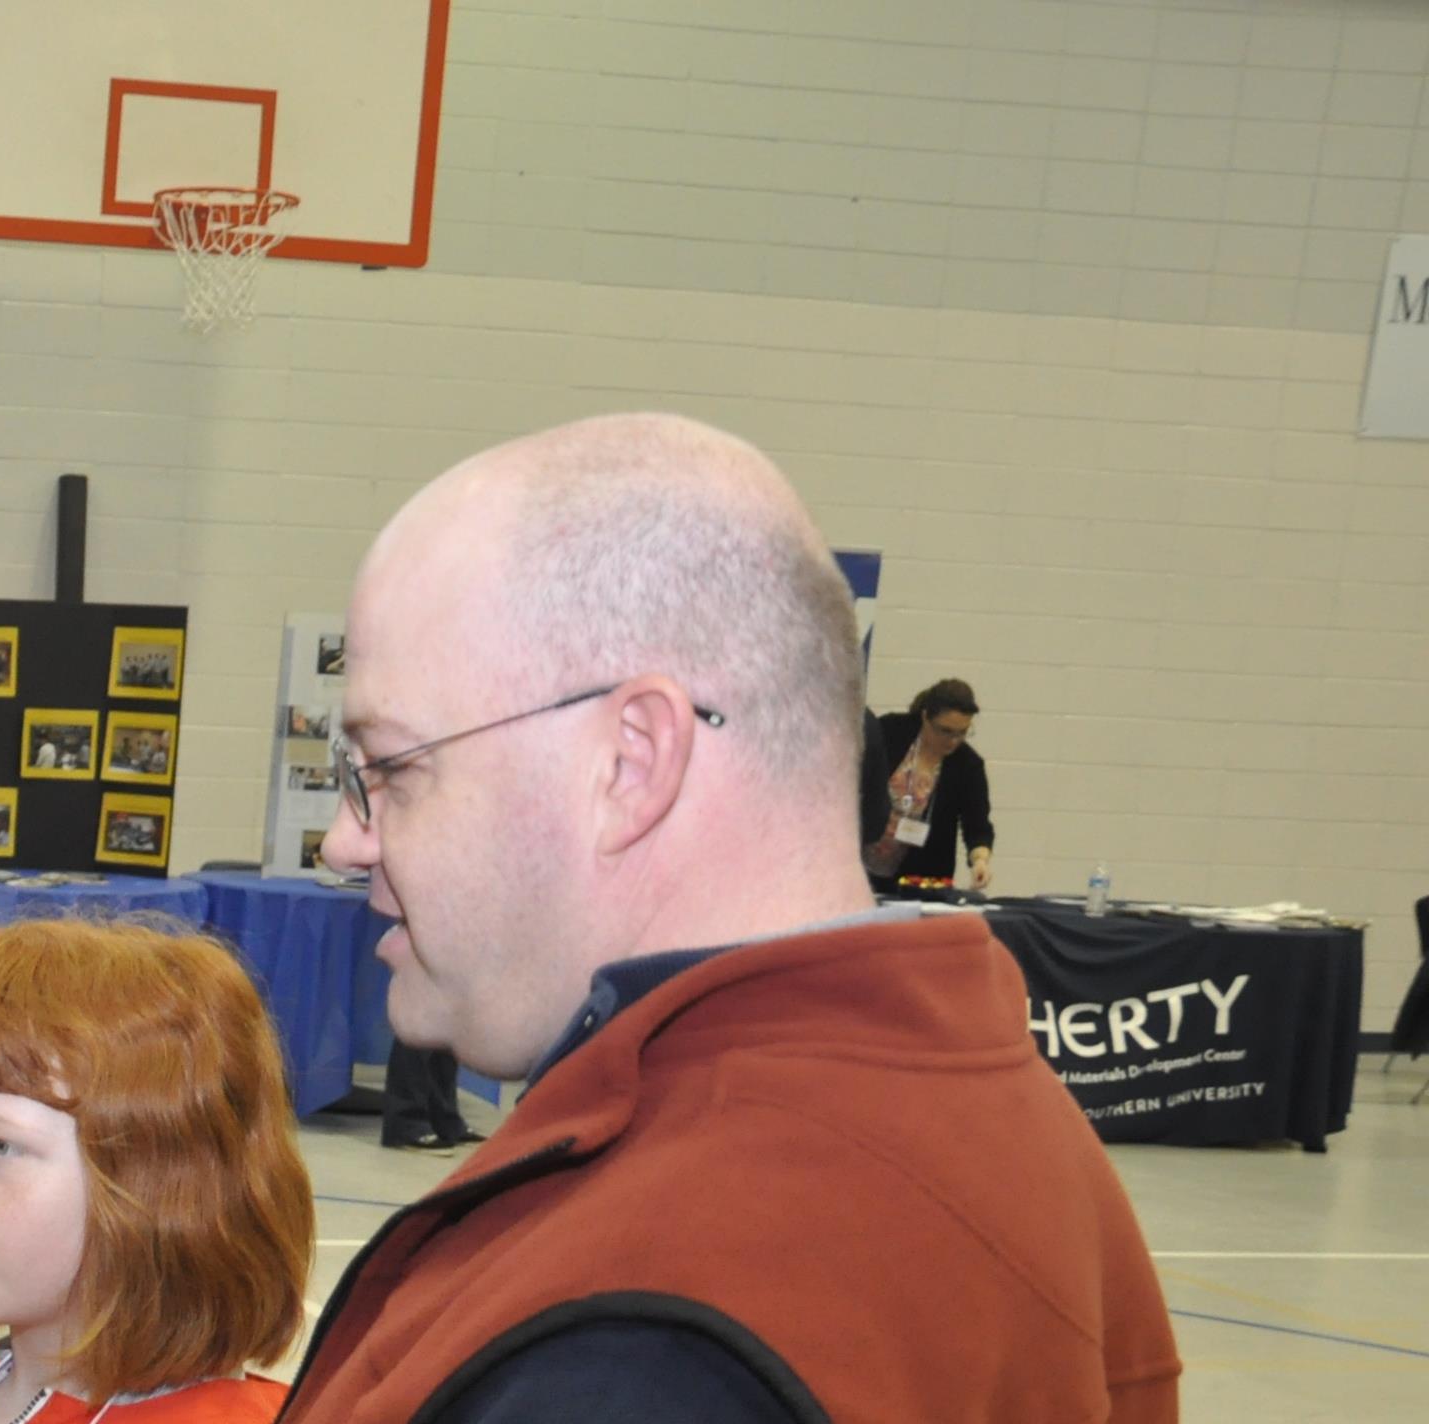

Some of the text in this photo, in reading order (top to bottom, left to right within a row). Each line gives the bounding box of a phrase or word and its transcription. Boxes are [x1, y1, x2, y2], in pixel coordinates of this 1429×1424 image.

[1069, 1068, 1127, 1084] Materials
[1086, 1082, 1266, 1119] OUTHERN UNIVERSITY
